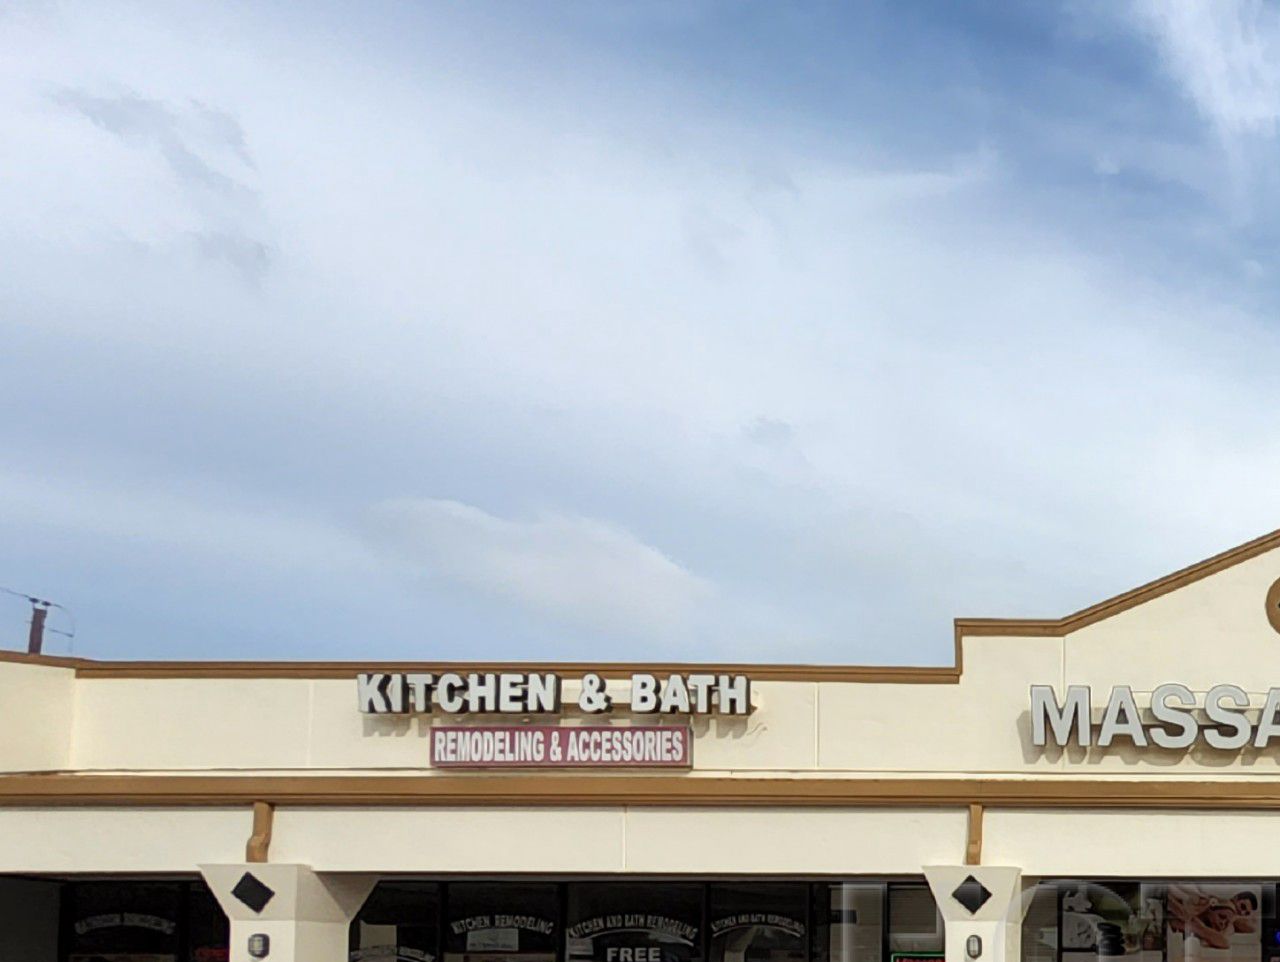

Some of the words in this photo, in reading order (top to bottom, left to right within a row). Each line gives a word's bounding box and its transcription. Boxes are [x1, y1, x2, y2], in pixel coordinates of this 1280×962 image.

[357, 673, 559, 714] KITCHEN
[579, 674, 608, 713] &
[631, 674, 750, 715] BATH
[434, 731, 544, 762] REMODELING
[550, 733, 562, 761] &
[567, 731, 684, 762] ACCESSORIES
